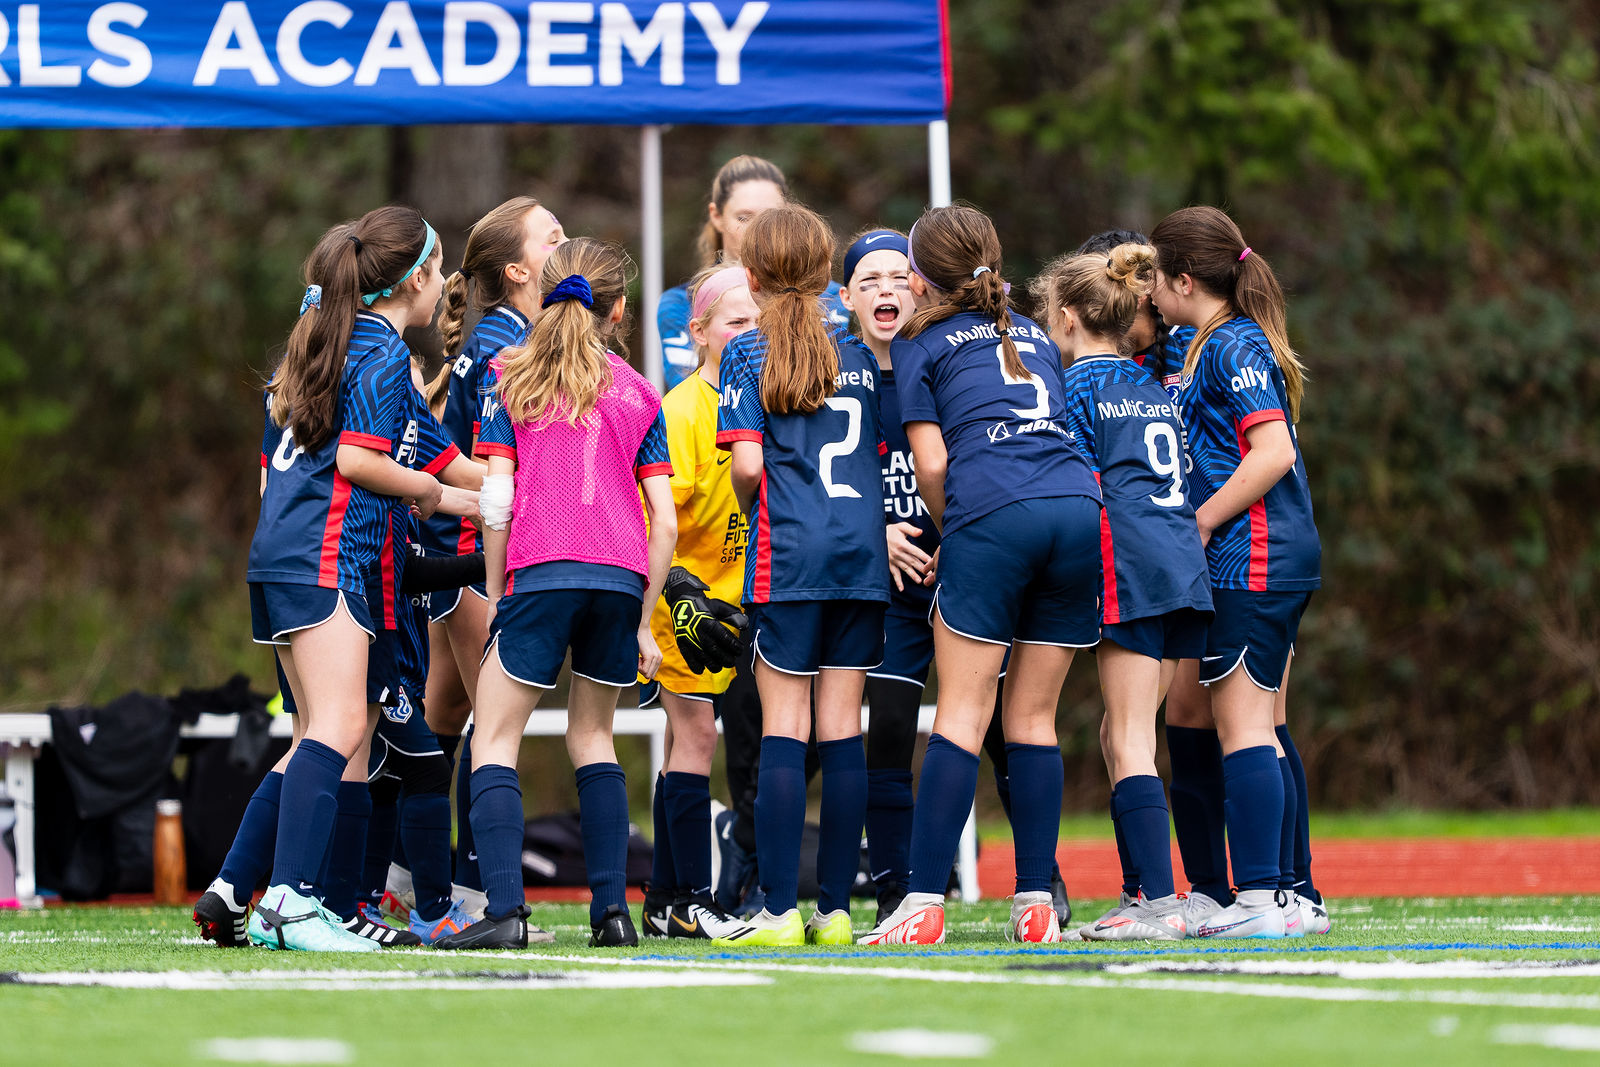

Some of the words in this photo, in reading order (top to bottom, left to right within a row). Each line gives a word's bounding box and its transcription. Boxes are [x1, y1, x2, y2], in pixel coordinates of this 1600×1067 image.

[0, 3, 152, 87] LS
[192, 0, 770, 86] ACADEMY
[995, 341, 1050, 419] 5
[1097, 398, 1172, 420] MultiCare
[1231, 366, 1268, 392] ally
[818, 396, 863, 498] 2
[1143, 422, 1185, 507] 9
